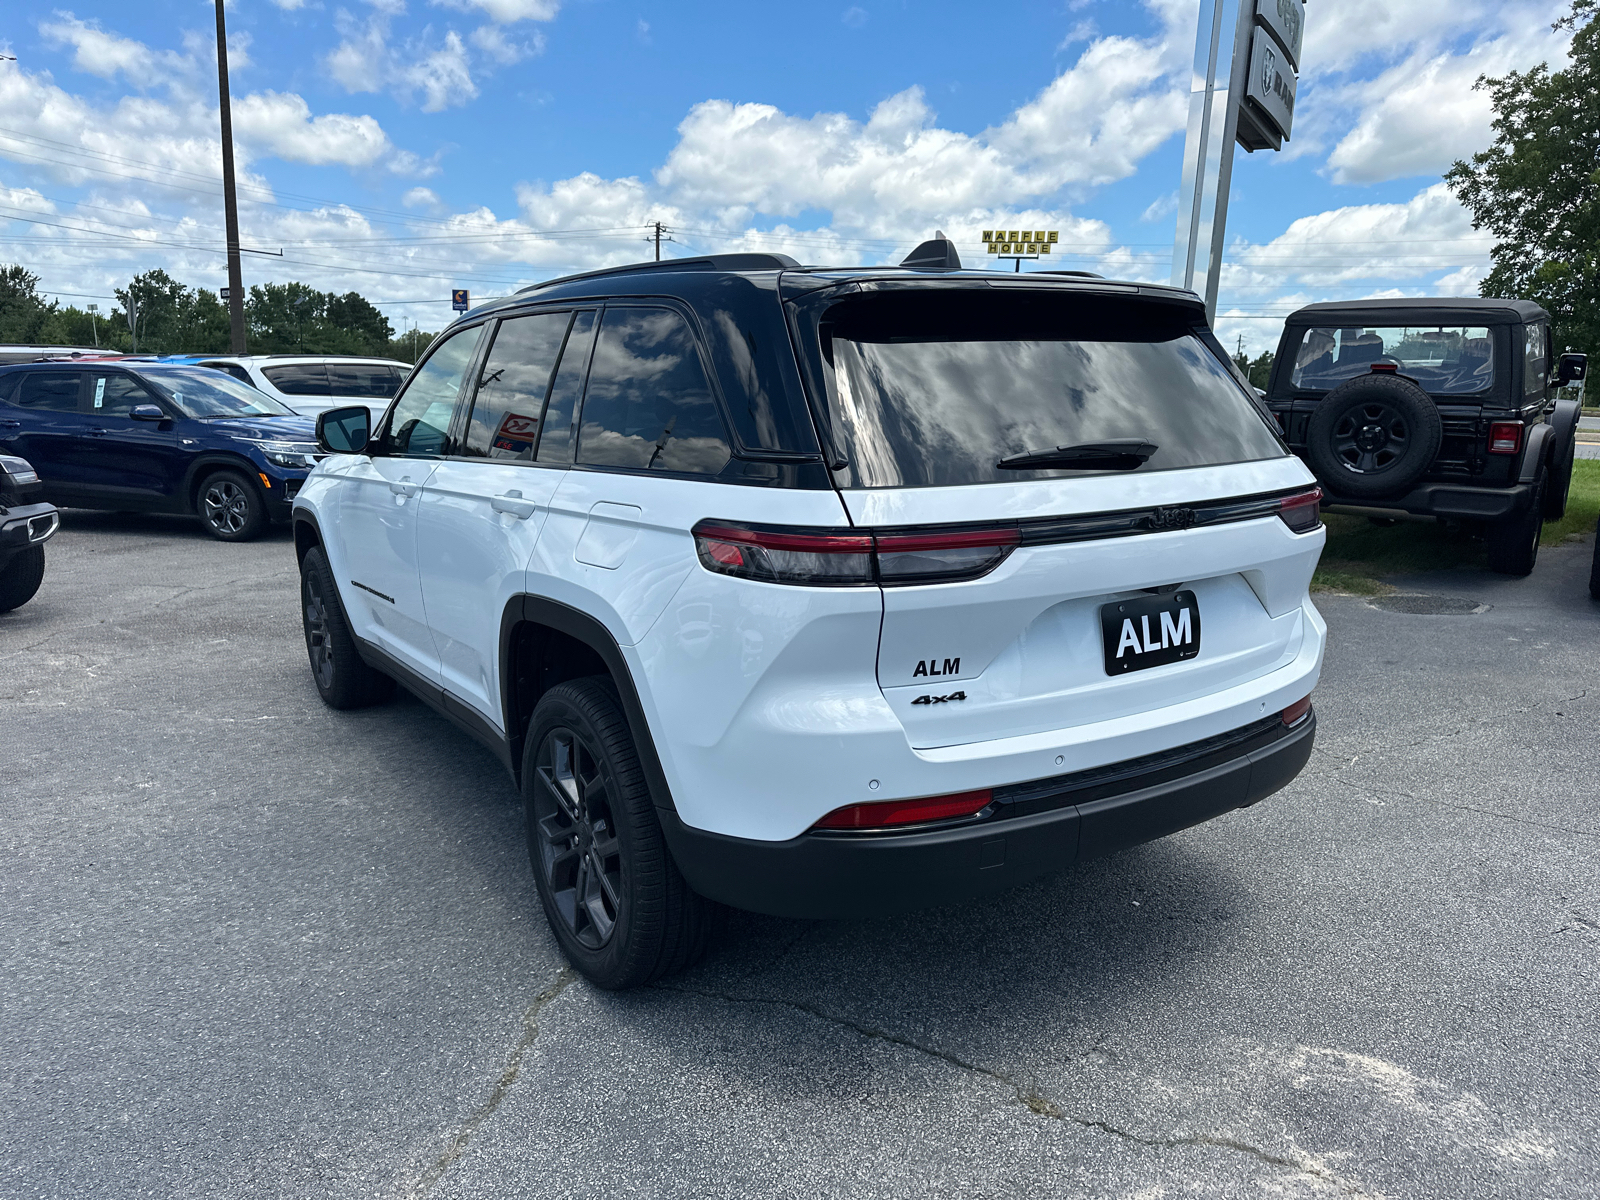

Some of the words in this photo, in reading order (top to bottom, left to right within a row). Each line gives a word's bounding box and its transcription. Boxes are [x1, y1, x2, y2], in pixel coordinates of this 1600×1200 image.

[1273, 71, 1294, 116] RAM
[983, 231, 1057, 241] WAFFLE
[989, 244, 1050, 253] HOUSE
[1149, 507, 1194, 529] Jeep
[1116, 607, 1192, 658] ALM
[913, 658, 961, 677] ALM
[911, 690, 968, 705] 4x4
